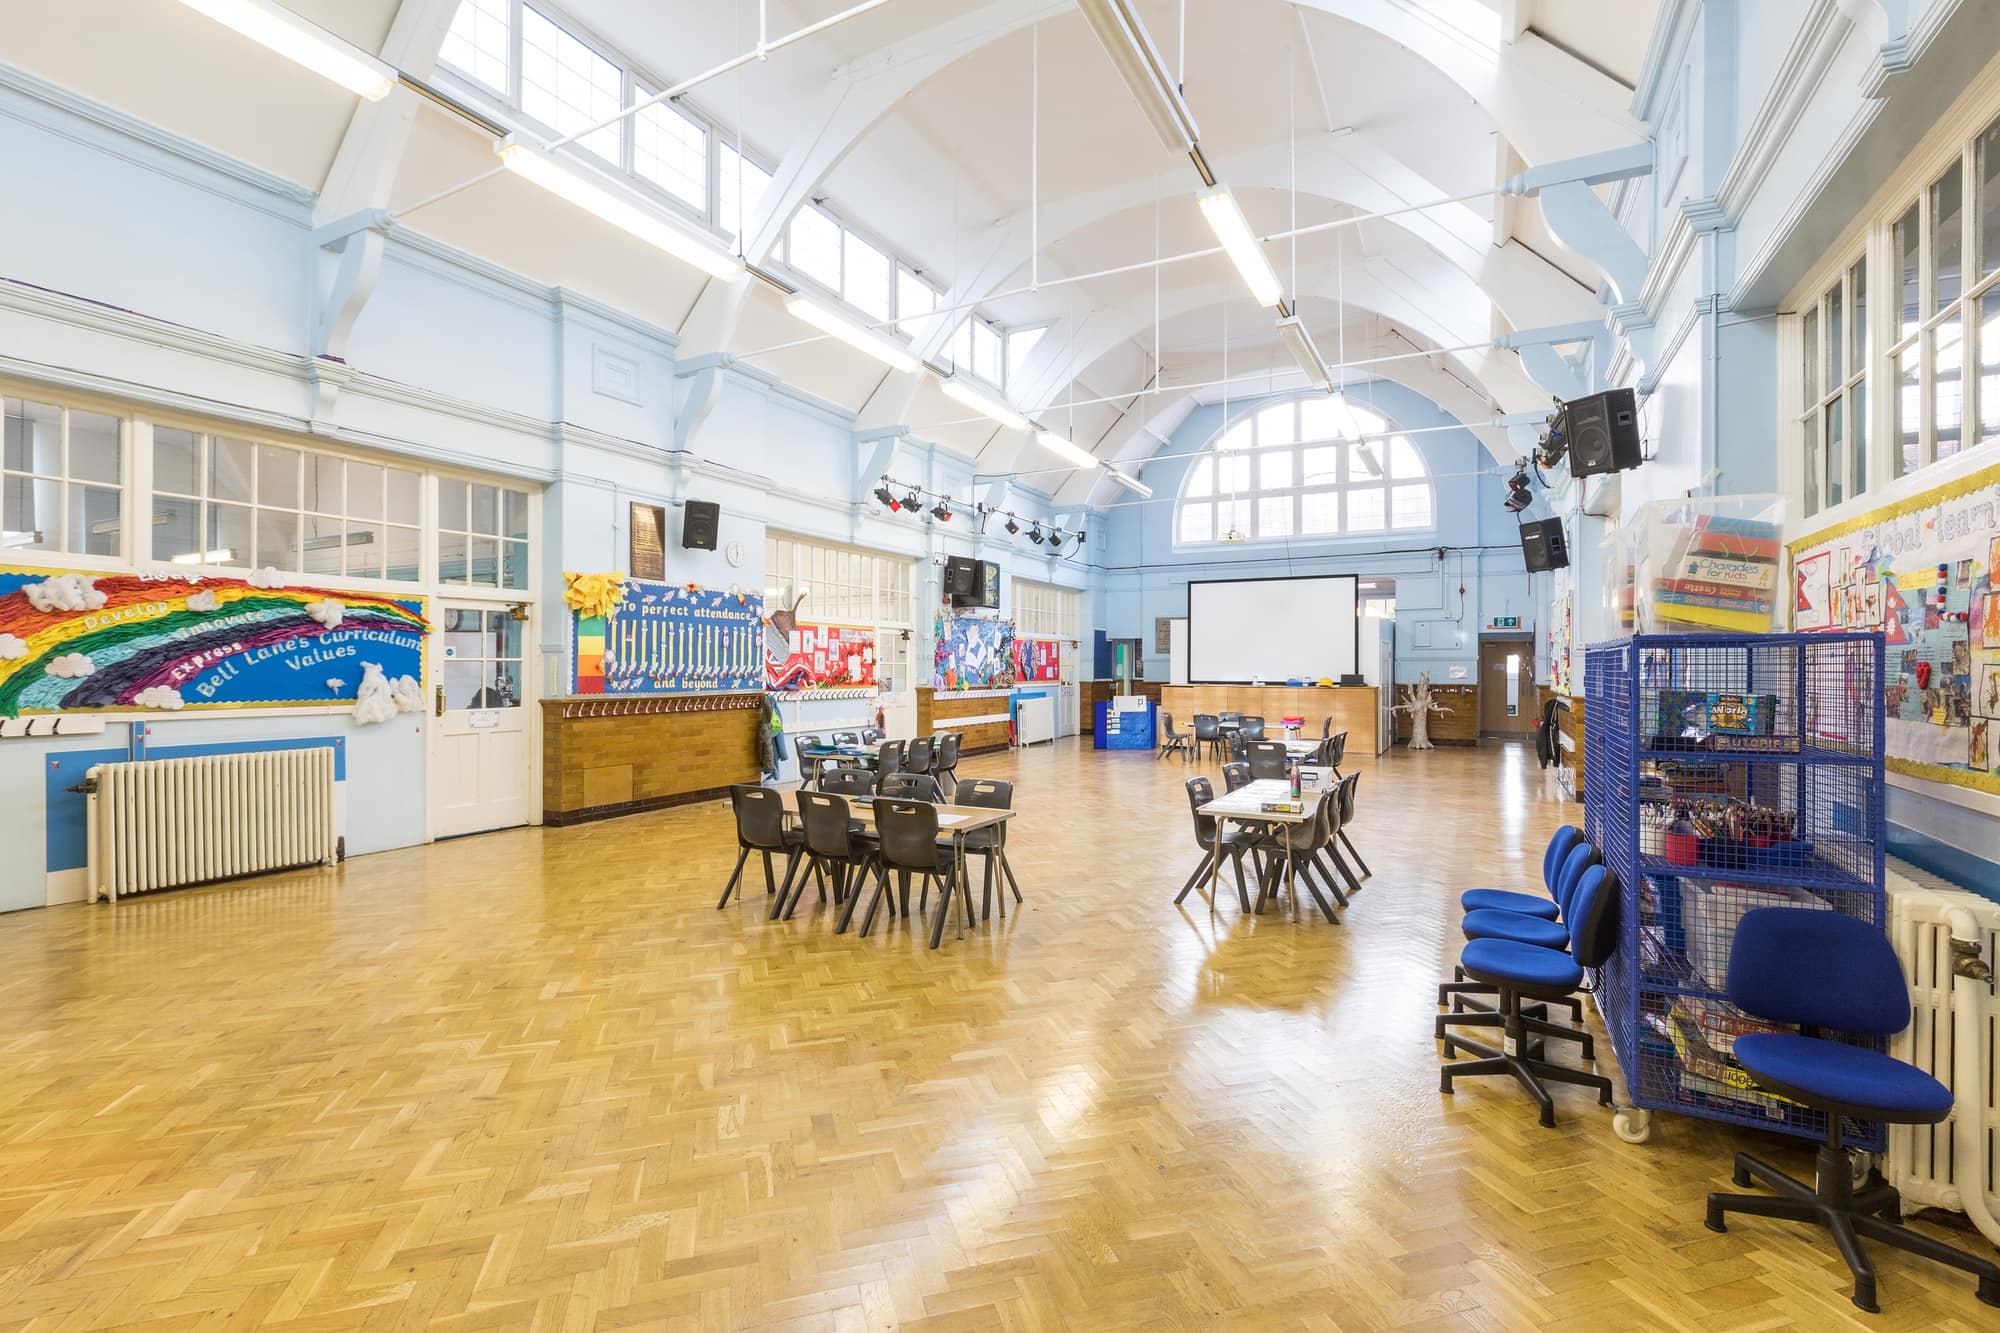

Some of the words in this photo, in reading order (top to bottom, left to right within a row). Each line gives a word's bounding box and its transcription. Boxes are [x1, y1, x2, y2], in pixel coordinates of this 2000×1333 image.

[1862, 511, 1922, 556] Global
[1700, 558, 1759, 574] Charades
[1706, 568, 1721, 578] for
[1724, 571, 1748, 580] Kids
[84, 602, 169, 630] Develop
[620, 600, 636, 612] To
[642, 604, 689, 617] perfect
[694, 608, 752, 620] attendance
[179, 611, 265, 640] Innovate
[171, 642, 242, 681] Express
[196, 660, 239, 698] Bell
[244, 635, 310, 666] Lane's
[319, 630, 422, 651] Curriculum
[285, 644, 357, 671] Values
[654, 677, 675, 688] and
